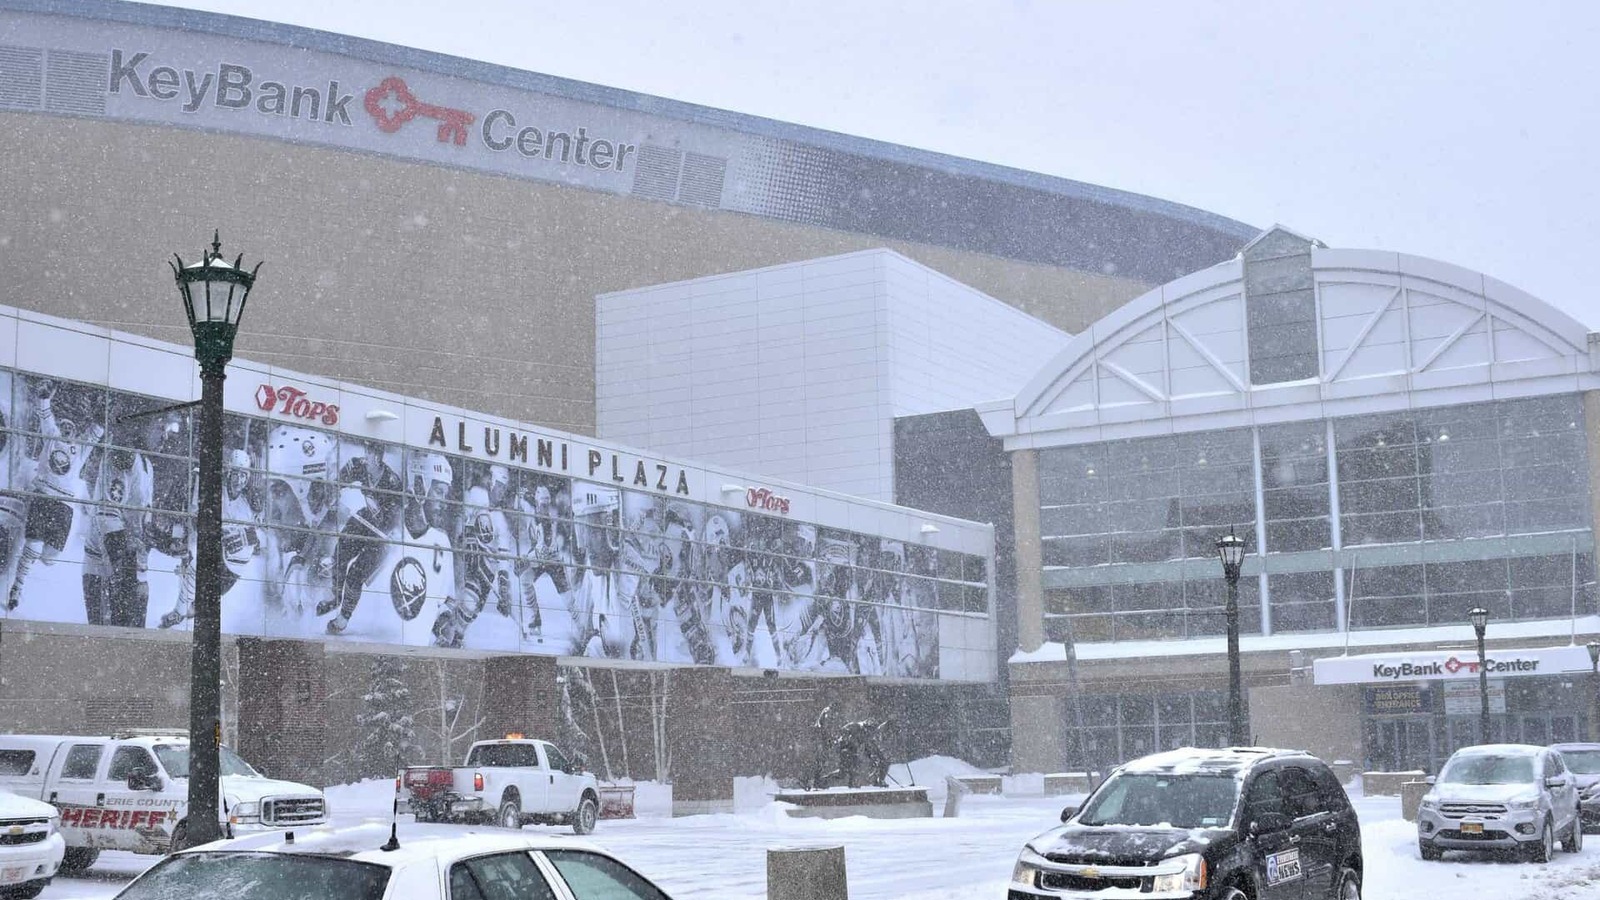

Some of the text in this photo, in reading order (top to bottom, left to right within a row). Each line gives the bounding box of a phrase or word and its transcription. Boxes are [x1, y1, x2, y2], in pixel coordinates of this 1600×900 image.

[108, 48, 635, 172] KeyBank Center
[428, 415, 689, 495] ALUMNI PLAZA
[1373, 658, 1539, 679] KeyBank Center
[105, 797, 190, 809] ERIE COUNTY
[60, 808, 168, 830] HERIFF
[1277, 860, 1301, 880] NEWS
